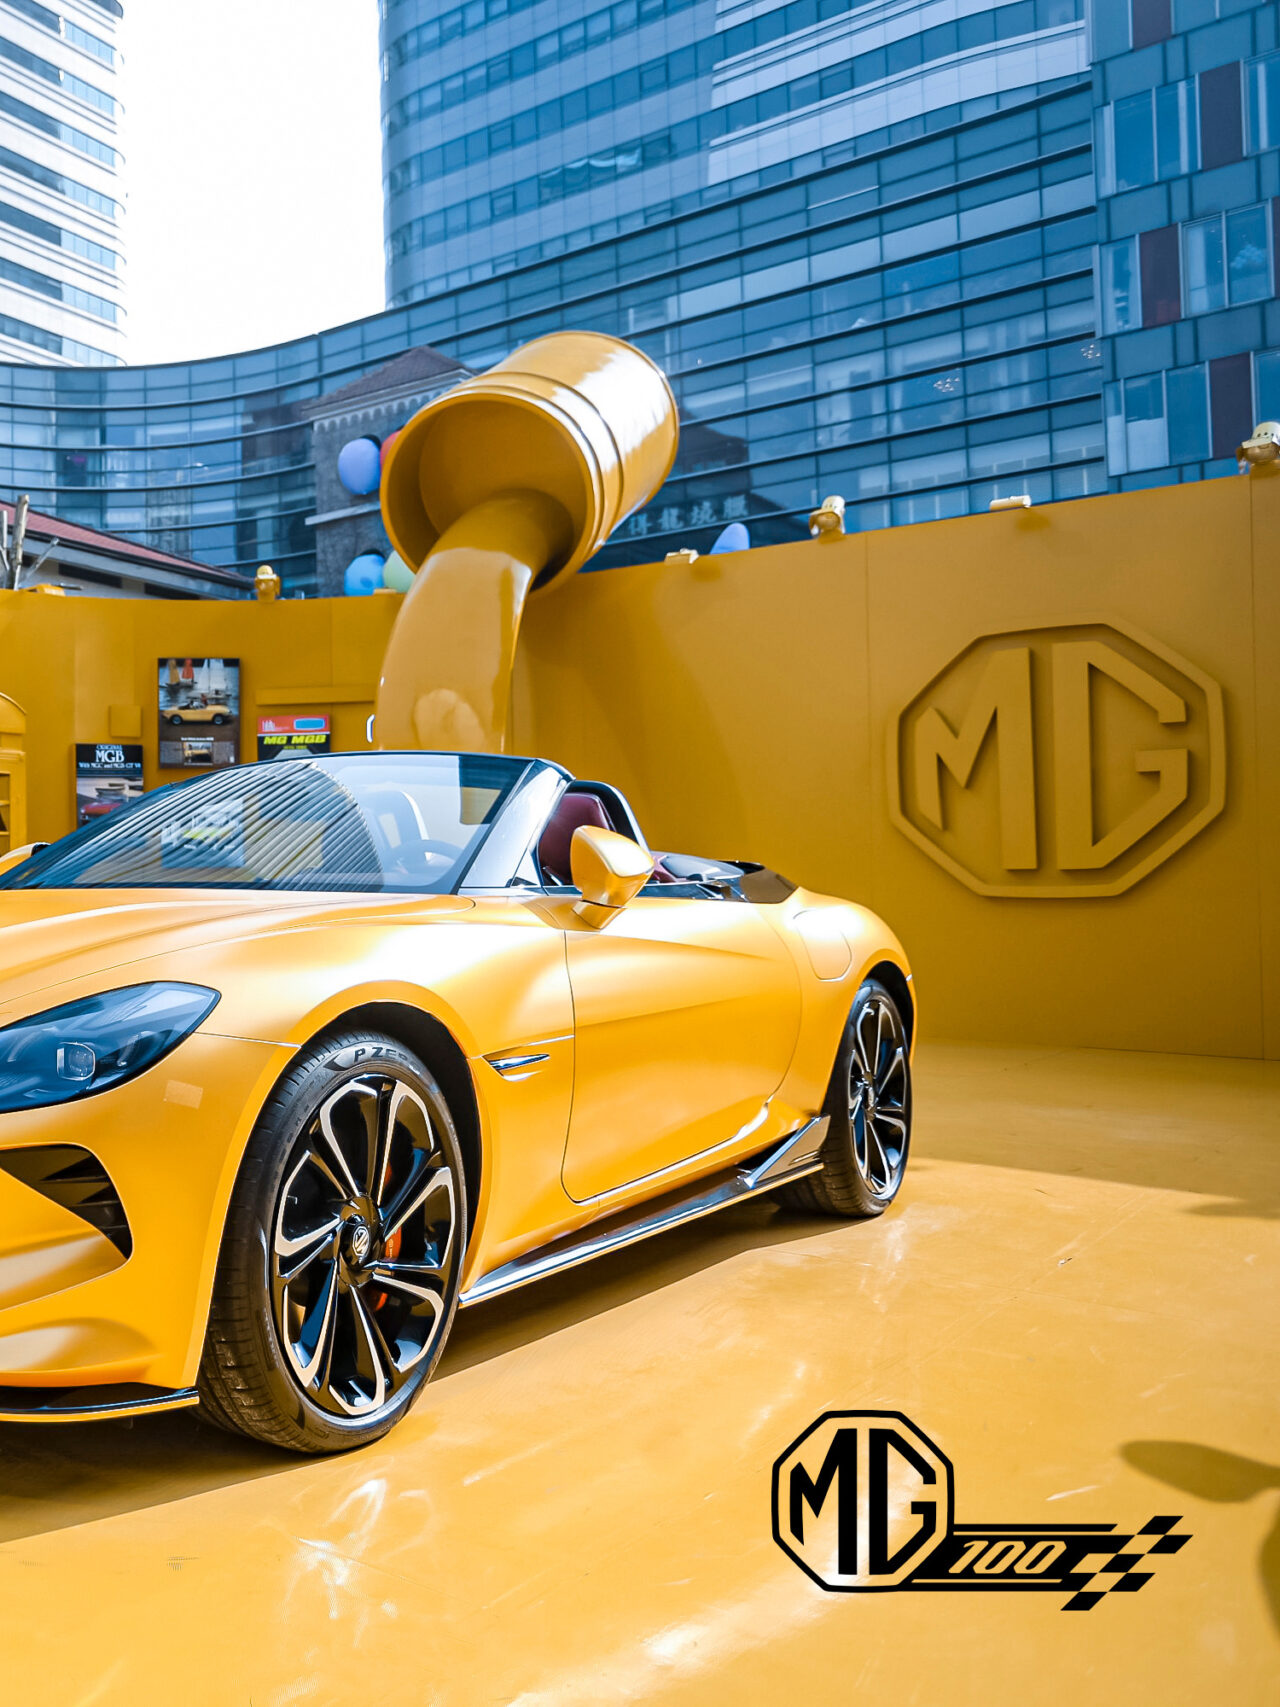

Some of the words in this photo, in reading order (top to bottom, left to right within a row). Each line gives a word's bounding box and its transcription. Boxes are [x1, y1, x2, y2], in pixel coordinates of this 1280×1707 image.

[291, 734, 327, 744] MGB
[95, 749, 125, 763] MGB
[915, 640, 1189, 870] MG
[353, 1047, 366, 1063] P
